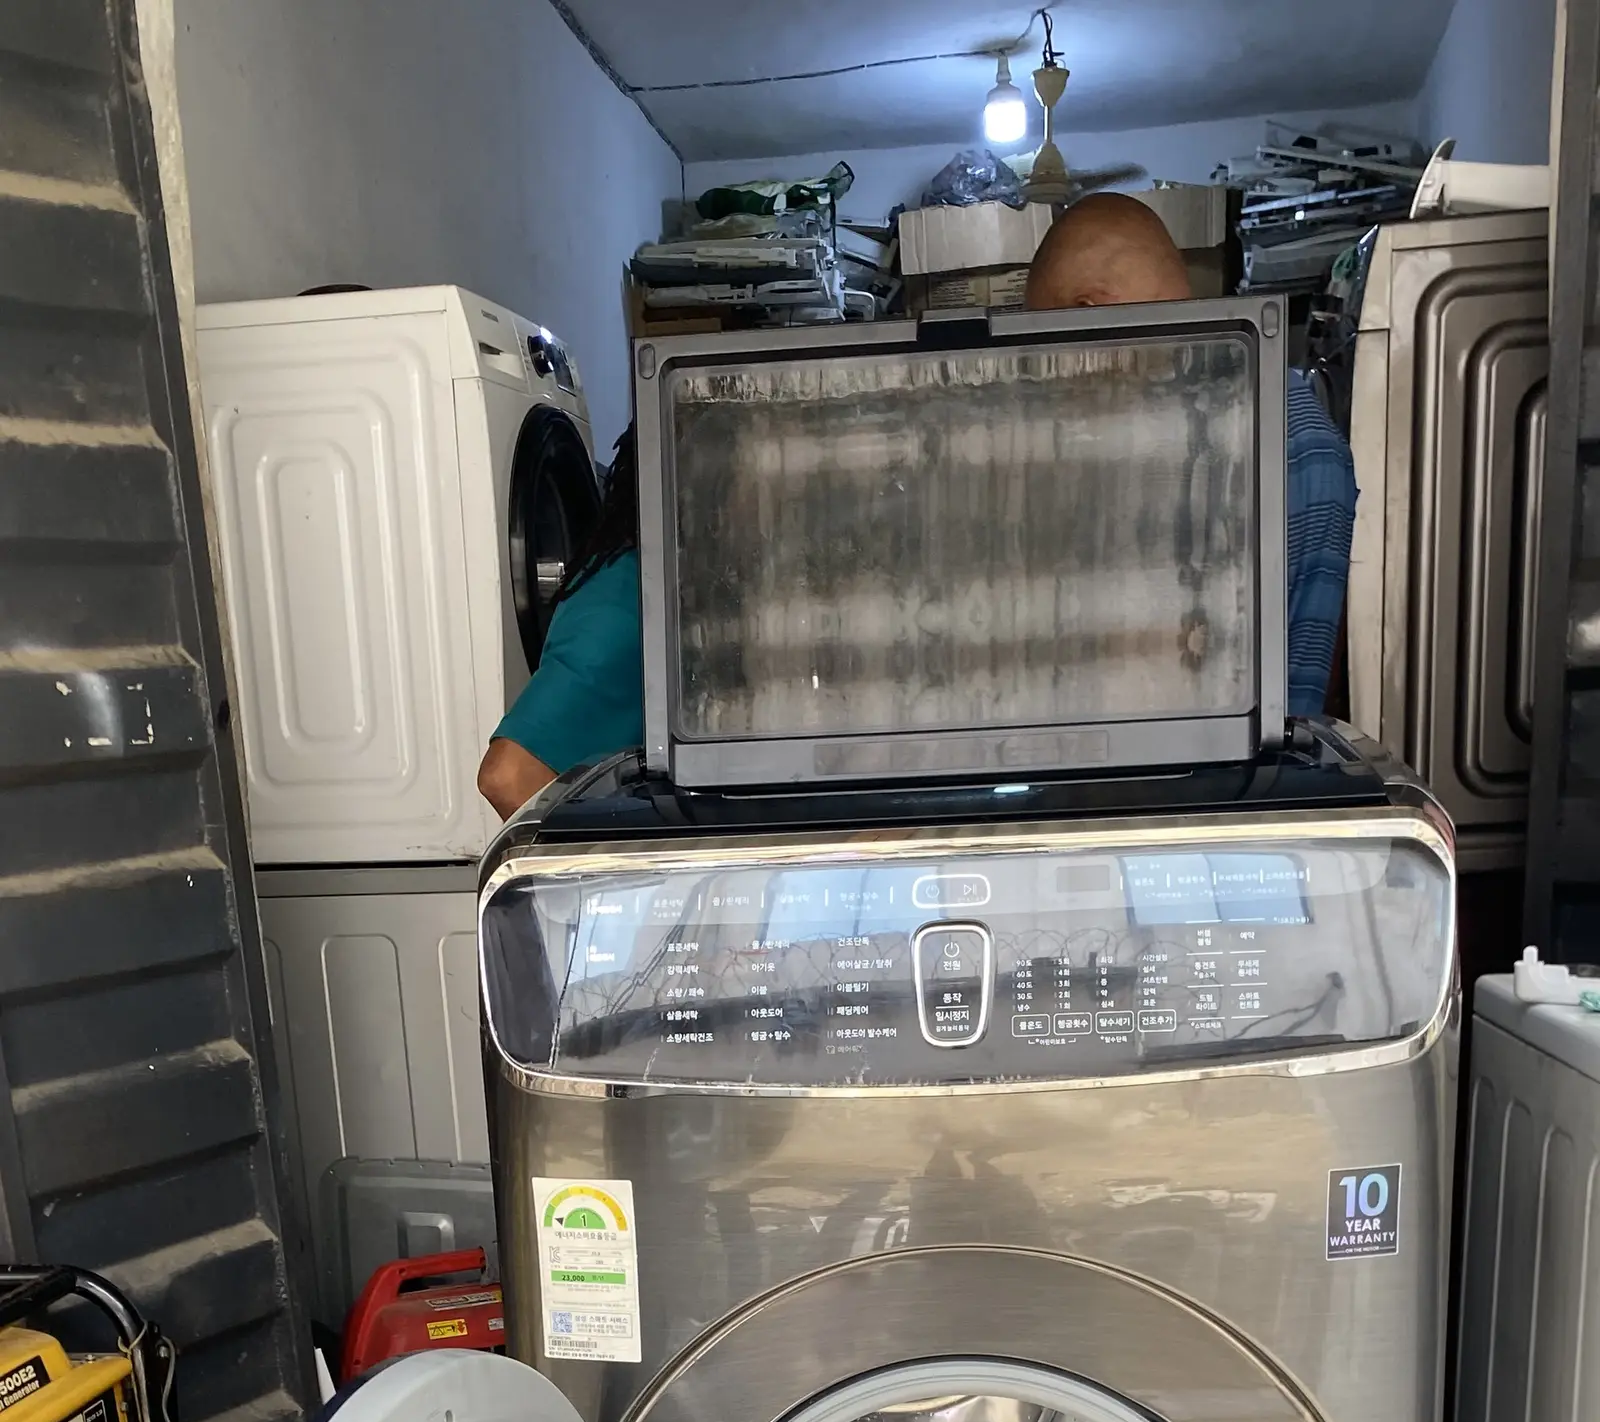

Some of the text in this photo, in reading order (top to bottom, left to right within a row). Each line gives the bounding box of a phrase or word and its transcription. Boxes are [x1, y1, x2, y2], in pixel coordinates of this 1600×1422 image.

[667, 942, 700, 952] 표준세탁
[837, 937, 870, 947] 건조단독
[752, 962, 775, 972] 아기옷
[837, 959, 893, 970] 에어살균/탈취
[943, 960, 961, 971] 전원
[667, 965, 700, 975] 강력세탁
[1058, 969, 1070, 977] 4회
[836, 982, 869, 992] 이불털기
[1016, 981, 1033, 989] 40도
[1058, 979, 1070, 987] 3회
[751, 986, 768, 995] 이불
[1058, 990, 1071, 998] 2회
[942, 992, 963, 1004] 동작
[1016, 992, 1033, 1000] 30도
[836, 1005, 869, 1016] 패딩케어
[1058, 1002, 1071, 1010] 1회
[666, 1010, 699, 1021] 삶음세탁
[751, 1008, 784, 1018] 아웃도어
[935, 1010, 970, 1022] 일시정지
[1099, 1017, 1131, 1027] 탈수세기
[1141, 1016, 1173, 1026] 건조추가
[751, 1031, 791, 1042] 헹굼+탈수
[836, 1027, 897, 1039] 아웃도어 발수케어
[666, 1033, 714, 1044] 소량세탁건조
[1339, 1173, 1389, 1218] 10
[580, 1214, 587, 1227] 1
[1345, 1218, 1380, 1233] YEAR
[1330, 1231, 1395, 1247] WARRANTY
[562, 1274, 585, 1282] 23,000
[3, 1380, 40, 1407] Generator
